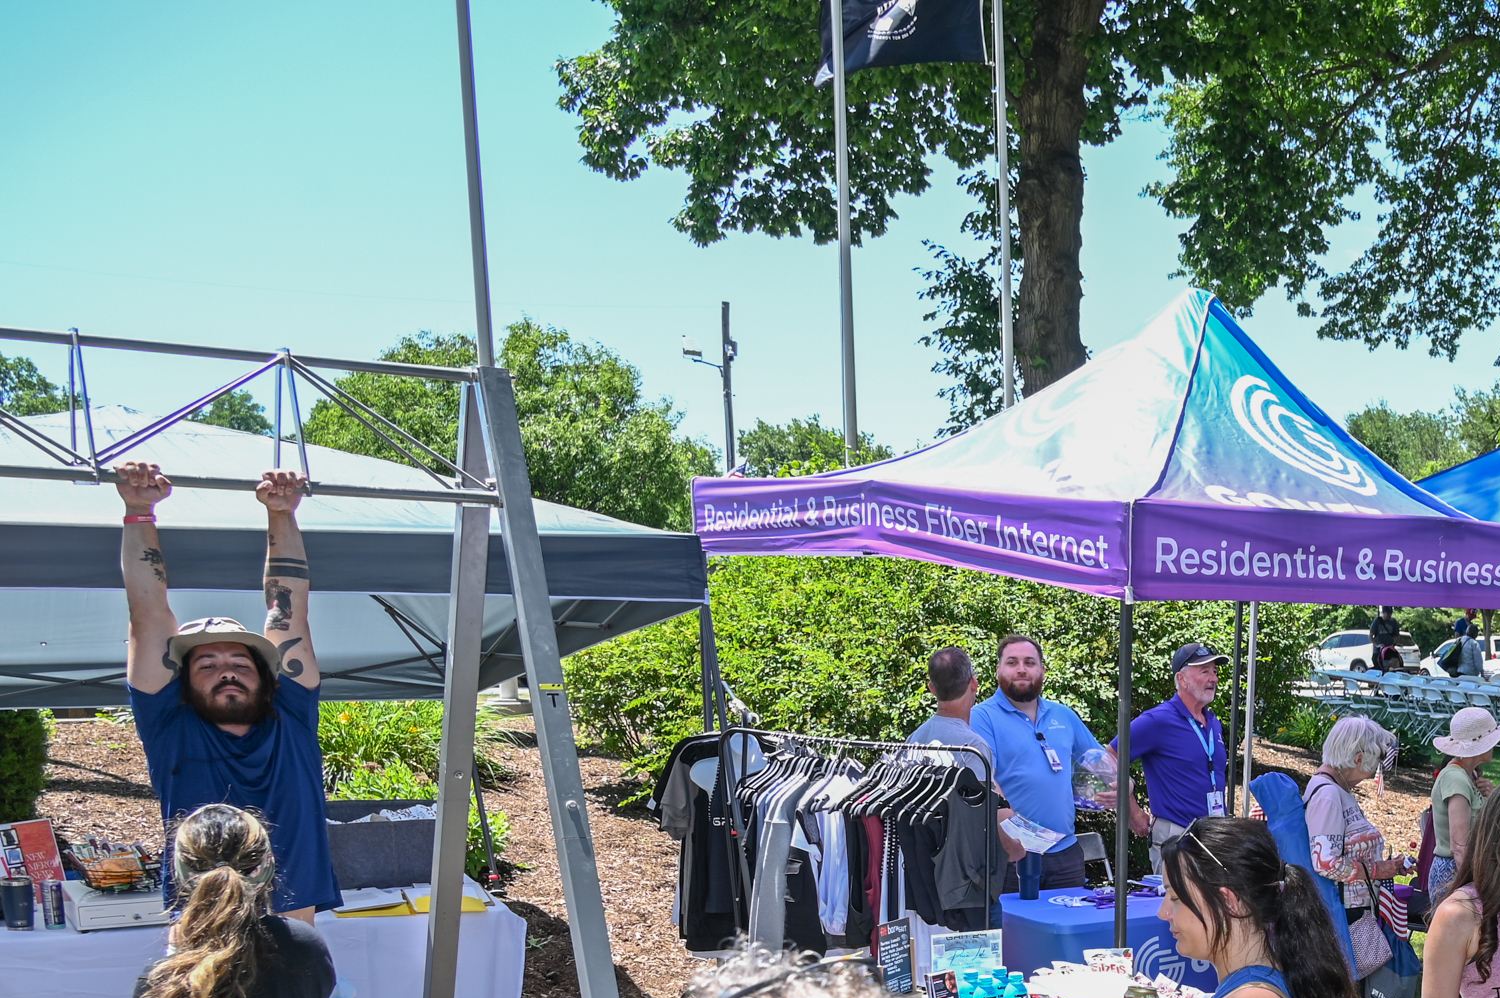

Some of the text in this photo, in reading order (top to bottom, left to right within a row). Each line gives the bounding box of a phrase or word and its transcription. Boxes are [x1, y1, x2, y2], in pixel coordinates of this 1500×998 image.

[703, 492, 1109, 570] Residential & Business Fiber Internet
[1154, 536, 1346, 581] Residential
[1355, 547, 1376, 581] &
